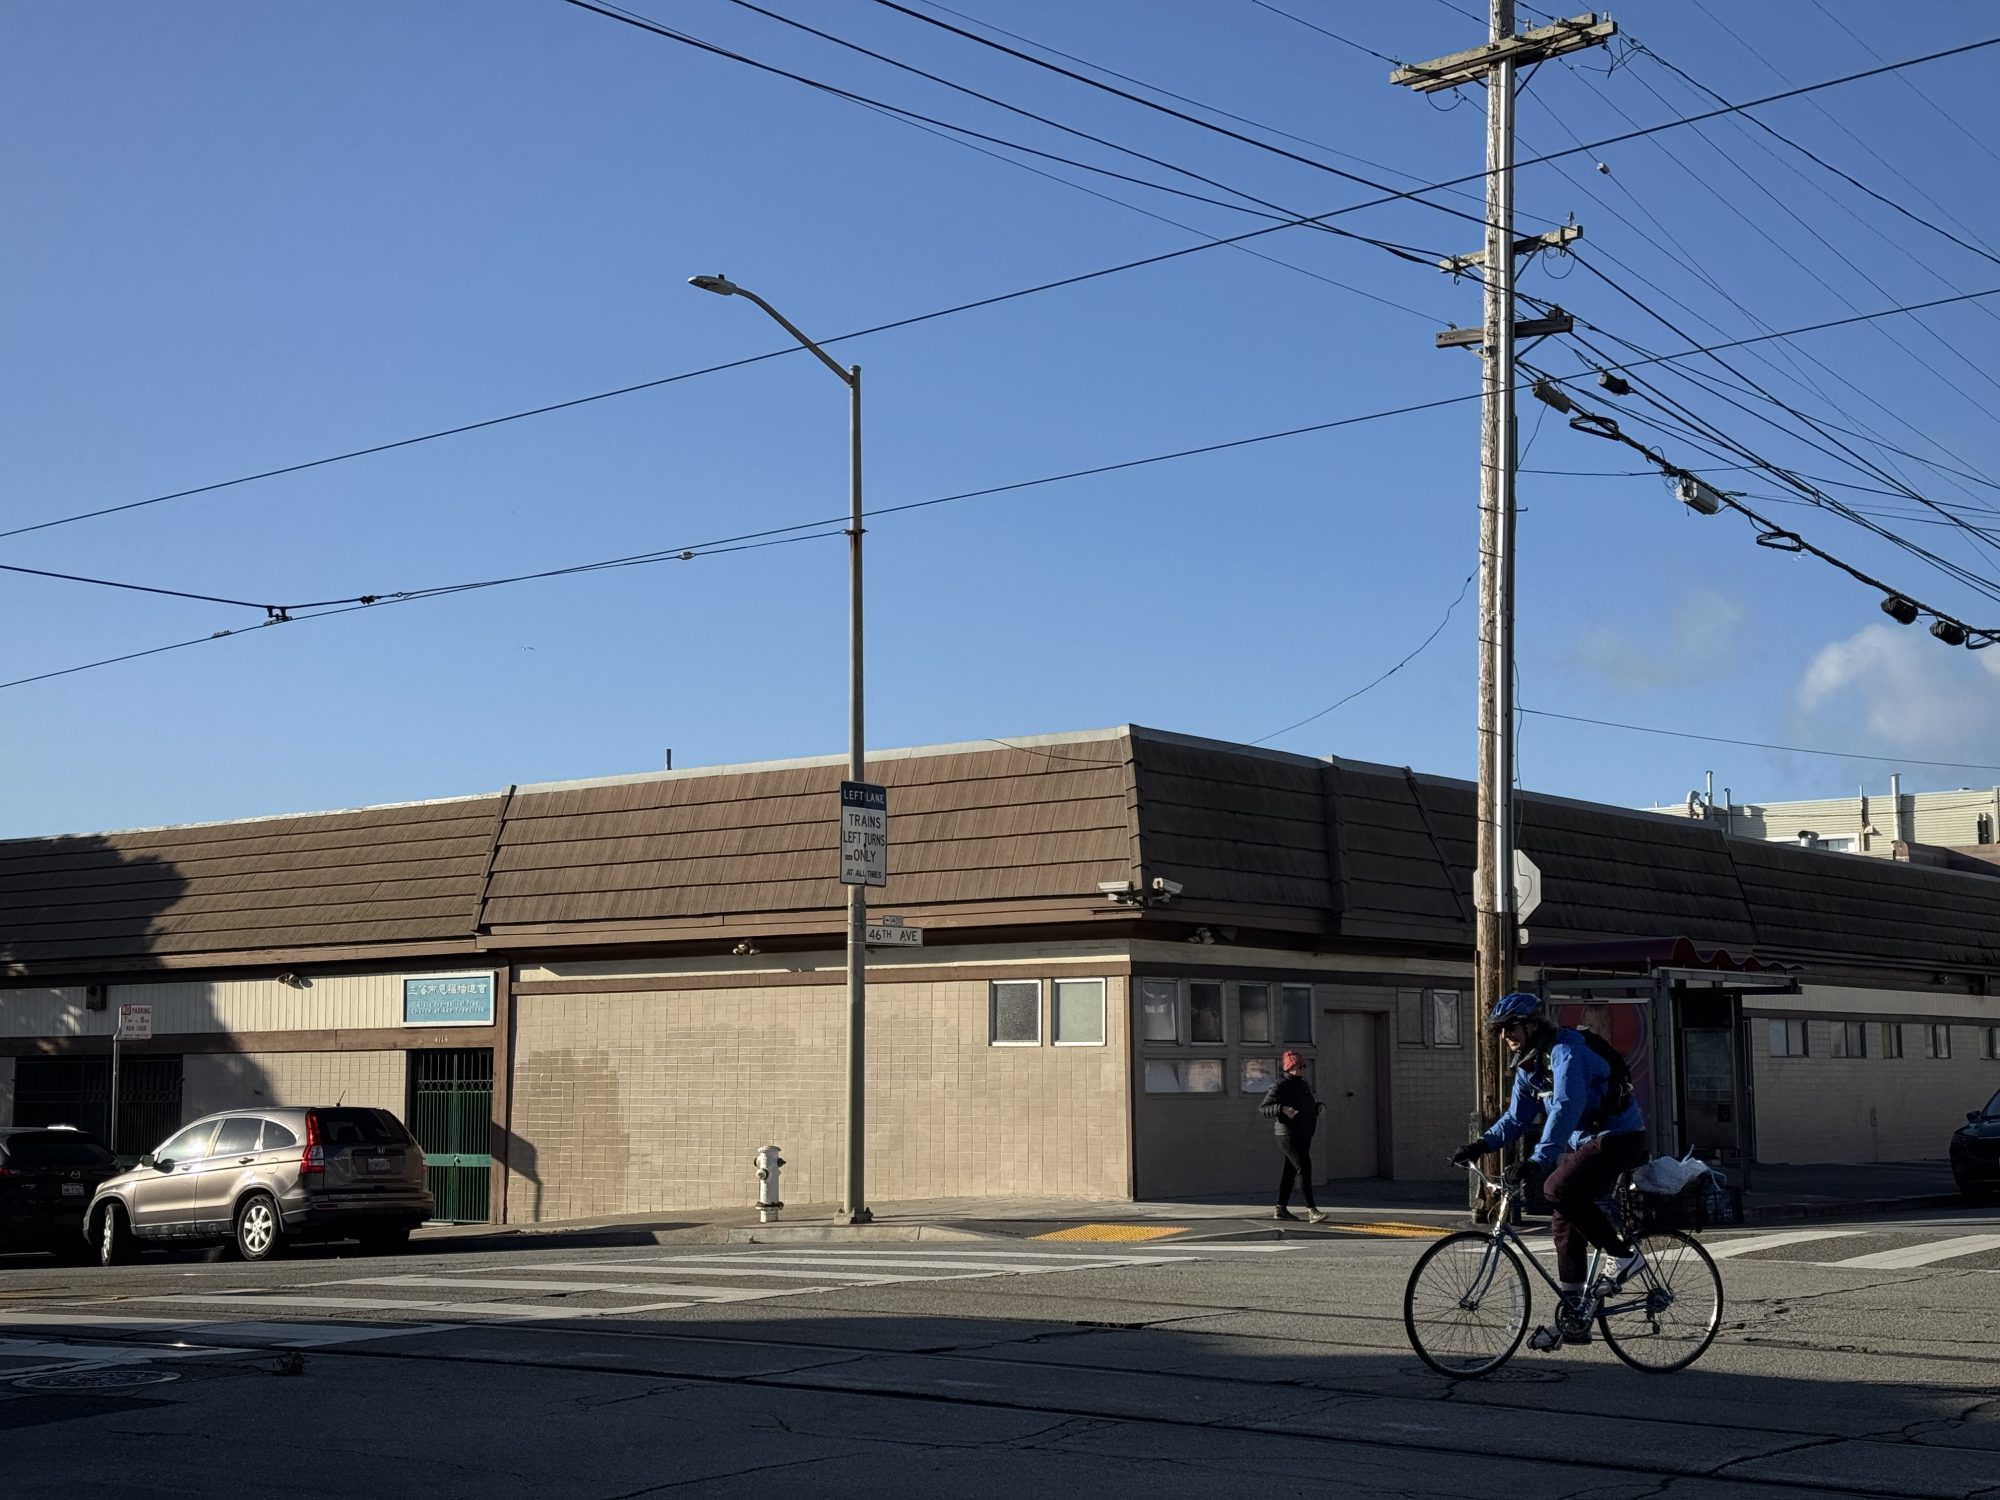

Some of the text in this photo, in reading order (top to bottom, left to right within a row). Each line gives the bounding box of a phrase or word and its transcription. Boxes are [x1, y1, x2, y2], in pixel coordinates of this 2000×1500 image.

[843, 789, 885, 804] LEFT LANE
[848, 813, 881, 829] TRAINS
[843, 830, 885, 847] LEFT TURNS
[853, 848, 876, 863] ONLY
[846, 868, 882, 879] AT ALL TIMES
[869, 928, 918, 942] 46TH AVE
